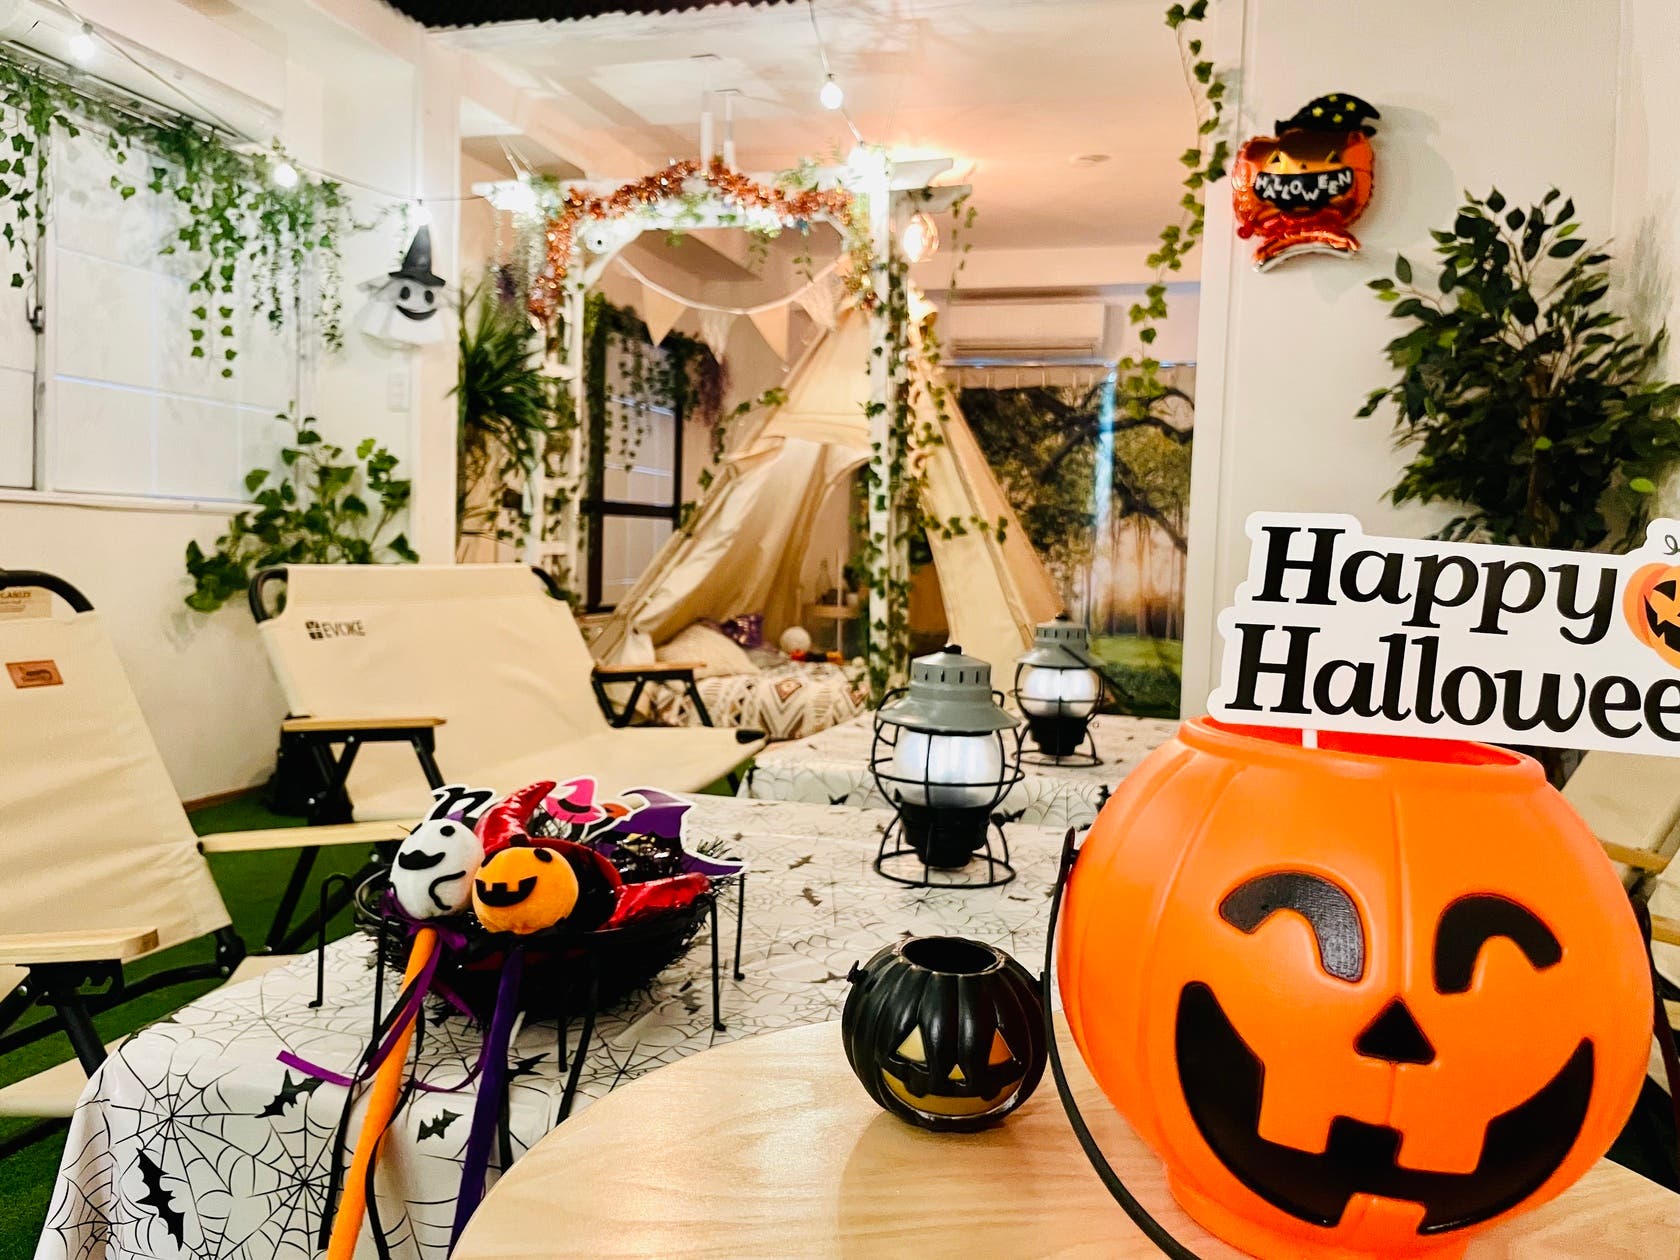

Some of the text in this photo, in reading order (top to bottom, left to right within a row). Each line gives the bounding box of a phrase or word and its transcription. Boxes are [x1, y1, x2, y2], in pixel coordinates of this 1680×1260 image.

[1255, 170, 1352, 201] HALLOWEEN
[1252, 526, 1618, 645] Happy
[322, 621, 366, 638] EVOKE
